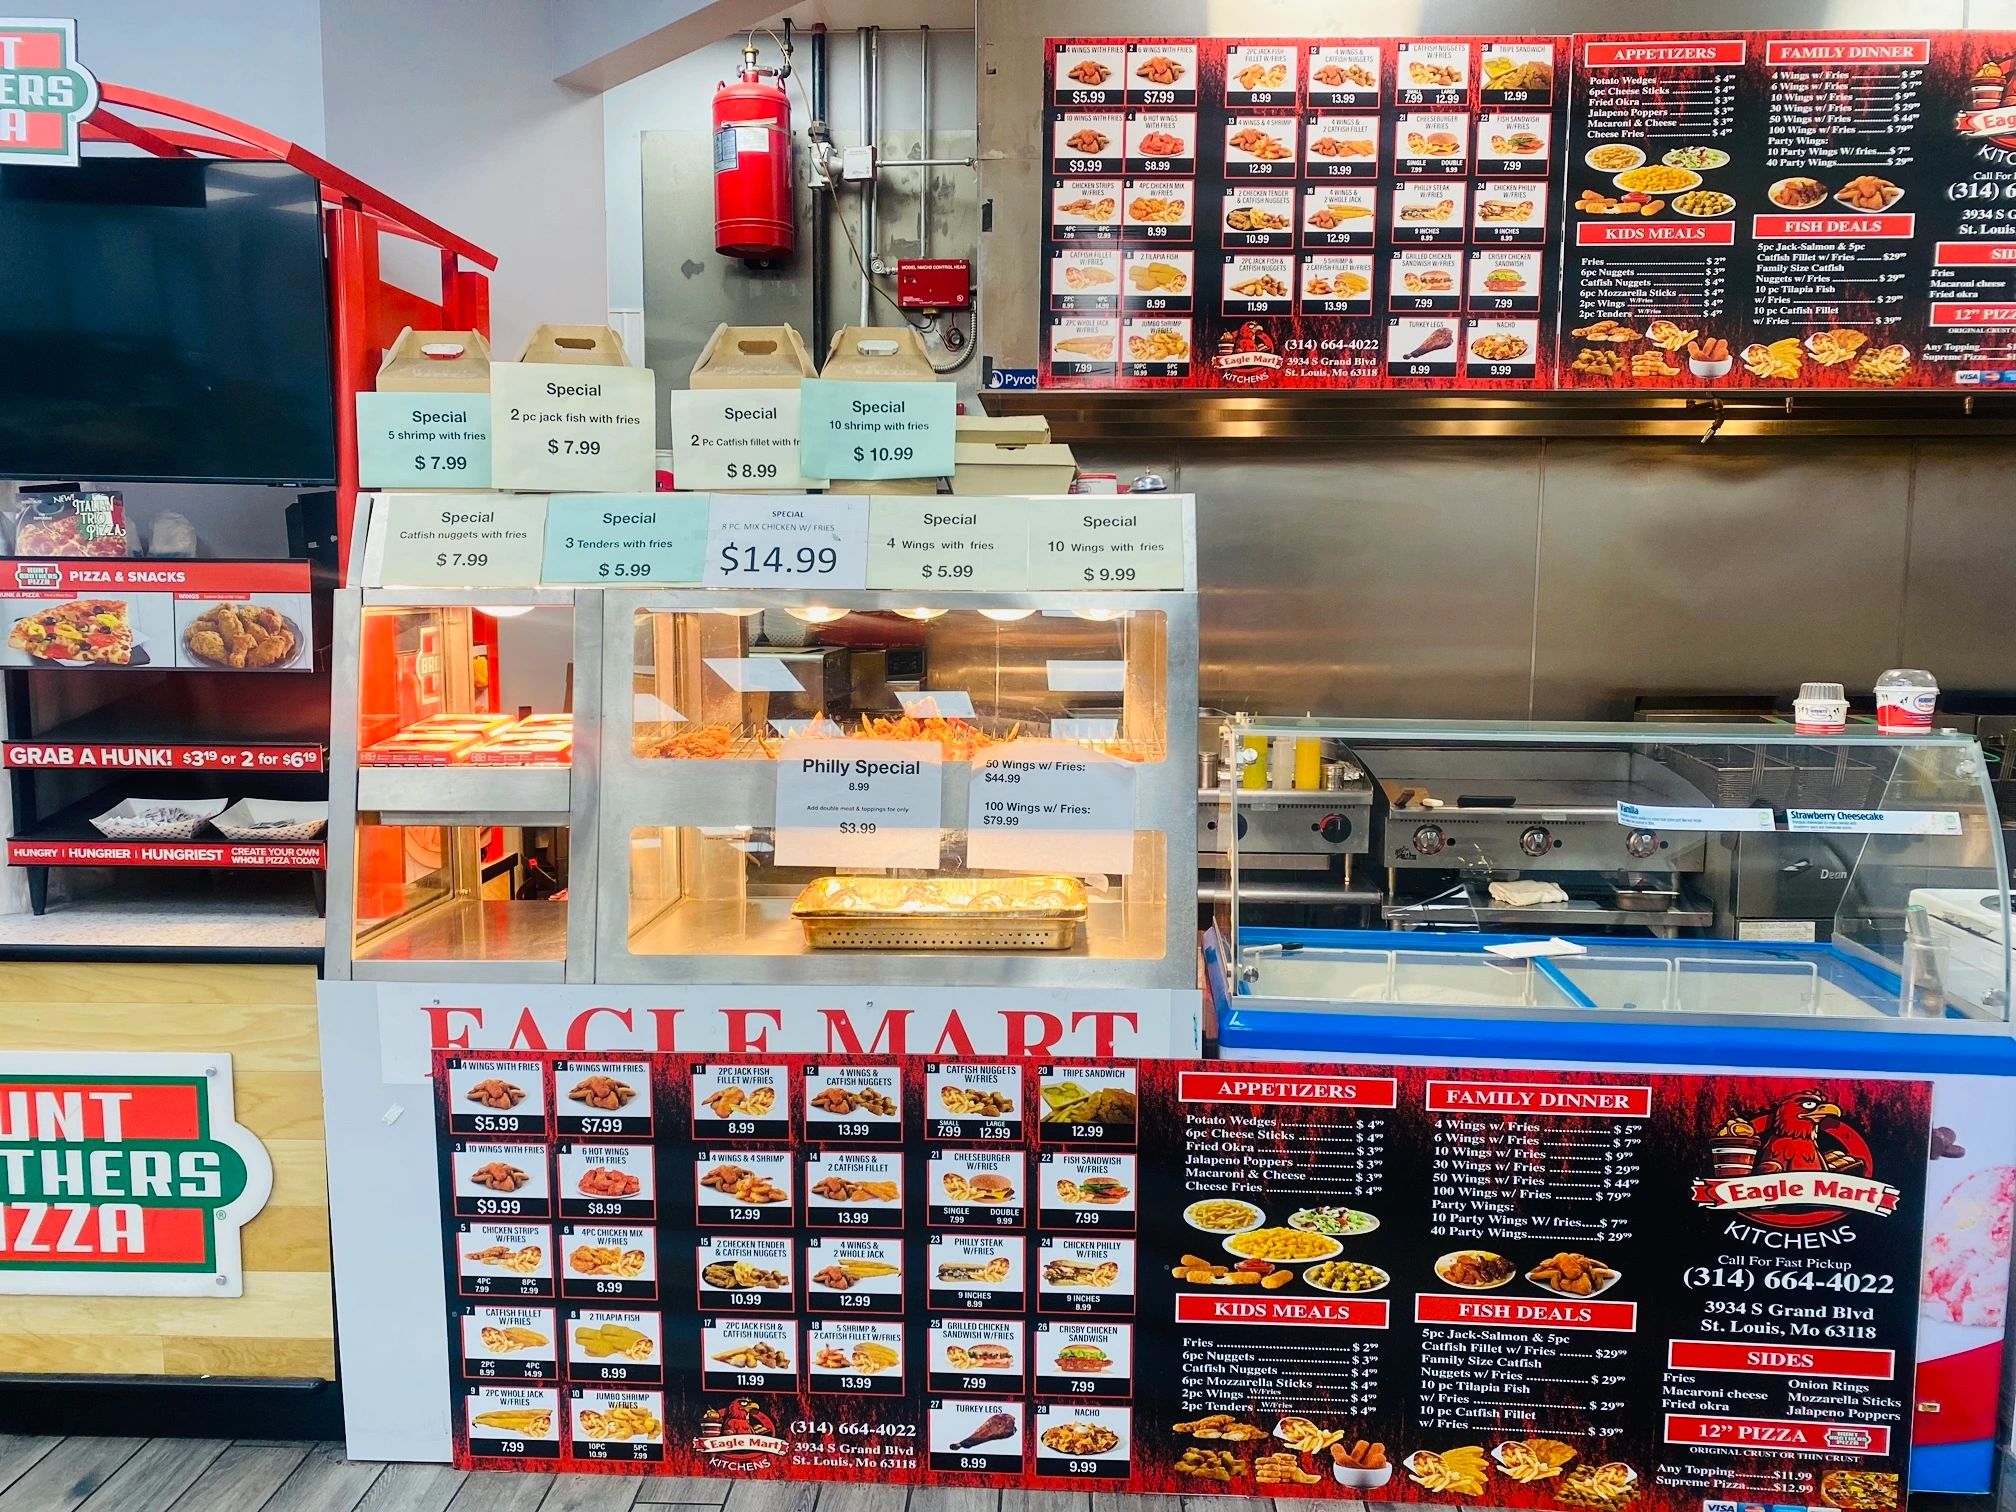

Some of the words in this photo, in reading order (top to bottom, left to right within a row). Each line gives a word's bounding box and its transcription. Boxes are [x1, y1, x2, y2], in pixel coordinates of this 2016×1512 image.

[1613, 47, 1716, 60] APPETIZERS
[1781, 46, 1845, 59] FAMILY
[1848, 45, 1914, 58] DINNER
[1072, 91, 1106, 103] $5.99
[1605, 228, 1645, 240] KIDS
[1648, 227, 1706, 239] MEALS
[1785, 221, 1826, 233] FISH
[1827, 220, 1883, 233] DEALS
[1284, 340, 1317, 351] (314)
[1321, 340, 1379, 350] 664-4022
[1005, 374, 1037, 386] Pyrot
[546, 383, 601, 398] Special
[724, 407, 777, 422] Special
[852, 400, 905, 415] Special
[412, 411, 467, 425] Special
[511, 409, 520, 420] 2
[523, 413, 536, 422] pc
[539, 412, 562, 424] jack
[566, 412, 586, 423] fish
[589, 413, 613, 424] with
[616, 414, 640, 424] fries
[829, 420, 842, 430] 10
[844, 421, 880, 432] shrimp
[884, 422, 905, 431] with
[908, 422, 929, 430] fries
[388, 431, 395, 440] 5
[398, 430, 436, 440] shrimp
[439, 431, 460, 440] with
[464, 431, 486, 440] fries
[691, 435, 700, 446] 2
[702, 438, 714, 446] Pc
[716, 438, 748, 446] Catfish
[750, 438, 770, 446] fillet
[772, 438, 791, 446] with
[548, 439, 559, 455] $
[564, 440, 601, 455] 7.99
[853, 446, 864, 462] $
[870, 447, 914, 461] 10.99
[415, 455, 426, 471] $
[430, 456, 467, 470] 7.99
[727, 463, 738, 478] $
[742, 464, 777, 478] 8.99
[73, 494, 115, 515] ITALIAN
[80, 512, 106, 525] TRIO
[603, 512, 656, 527] Special
[86, 523, 126, 540] PIZZA
[565, 537, 574, 549] 3
[578, 540, 620, 550] Tenders
[622, 540, 646, 548] with
[648, 539, 673, 548] fries
[720, 542, 837, 575] $14.99
[69, 571, 111, 582] PIZZA
[114, 572, 124, 582] &
[128, 572, 186, 583] SNACKS
[599, 563, 610, 578] $
[614, 564, 651, 576] 5.99
[10, 747, 74, 766] GRAB
[79, 748, 98, 766] A
[101, 748, 173, 767] HUNK!
[220, 753, 236, 764] or
[240, 752, 254, 767] 2
[258, 752, 278, 765] for
[802, 759, 850, 776] Philly
[855, 760, 920, 777] Special
[986, 760, 999, 768] 50
[1002, 761, 1036, 772] Wings
[1038, 761, 1053, 771] w/
[1055, 762, 1086, 772] Fries:
[985, 772, 1021, 784] $44.99
[848, 782, 870, 792] 8.99
[984, 801, 1004, 811] 100
[1006, 802, 1041, 814] Wings
[1043, 804, 1058, 813] w/
[1060, 804, 1091, 814] Fries:
[984, 815, 1019, 826] $79.99
[1790, 810, 1835, 822] Strawberry
[1837, 811, 1884, 822] Cheesecake
[840, 822, 877, 835] $3.99
[14, 848, 58, 858] HUNGRY
[68, 848, 130, 859] HUNGRIER
[142, 849, 224, 860] HUNGRIEST
[231, 848, 265, 856] CREATE
[266, 848, 294, 856] YOUR
[296, 848, 320, 856] OWN
[232, 856, 264, 864] WHOLE
[266, 856, 290, 864] PIZZA
[291, 857, 320, 865] TODAY
[1820, 868, 1848, 880] Dean
[946, 1066, 978, 1074] CATFISH
[980, 1066, 1016, 1075] NUGGETS
[1062, 1069, 1084, 1078] TRIPE
[1085, 1069, 1125, 1078] SANDWICH
[1218, 1081, 1357, 1099] APPETIZERS
[1446, 1089, 1535, 1104] FAMILY
[1540, 1093, 1631, 1109] DINNER
[0, 1091, 133, 1142] UNT
[475, 1116, 519, 1132] $5.99
[1186, 1114, 1226, 1125] Potato
[1230, 1115, 1277, 1127] Wedges
[581, 1117, 623, 1133] $7.99
[1072, 1126, 1104, 1138] 12.99
[0, 1149, 221, 1198] THERS
[1728, 1180, 1804, 1202] Eagle
[1814, 1180, 1879, 1204] Mart
[477, 1199, 521, 1215] $9.99
[0, 1202, 145, 1253] ZZA
[1723, 1220, 1857, 1250] KITCHENS
[1718, 1255, 1744, 1266] Call
[1749, 1256, 1772, 1267] For
[1775, 1256, 1803, 1268] Fast
[1807, 1258, 1852, 1272] Pickup
[1684, 1266, 1755, 1292] (314)
[1764, 1270, 1895, 1294] 664-4022
[1214, 1302, 1267, 1317] KIDS
[1272, 1304, 1350, 1320] MEALS
[1458, 1304, 1512, 1319] FISH
[1516, 1305, 1592, 1322] DEALS
[1704, 1300, 1747, 1315] 3934
[1751, 1302, 1763, 1316] S
[1768, 1304, 1827, 1318] Grand
[1832, 1306, 1874, 1320] Blvd
[1700, 1318, 1725, 1332] St.
[1730, 1320, 1786, 1337] Louis,
[1790, 1322, 1820, 1337] Mo
[1824, 1325, 1877, 1340] 63118
[1747, 1352, 1814, 1368] SIDES
[1738, 1426, 1808, 1444] PIZZA
